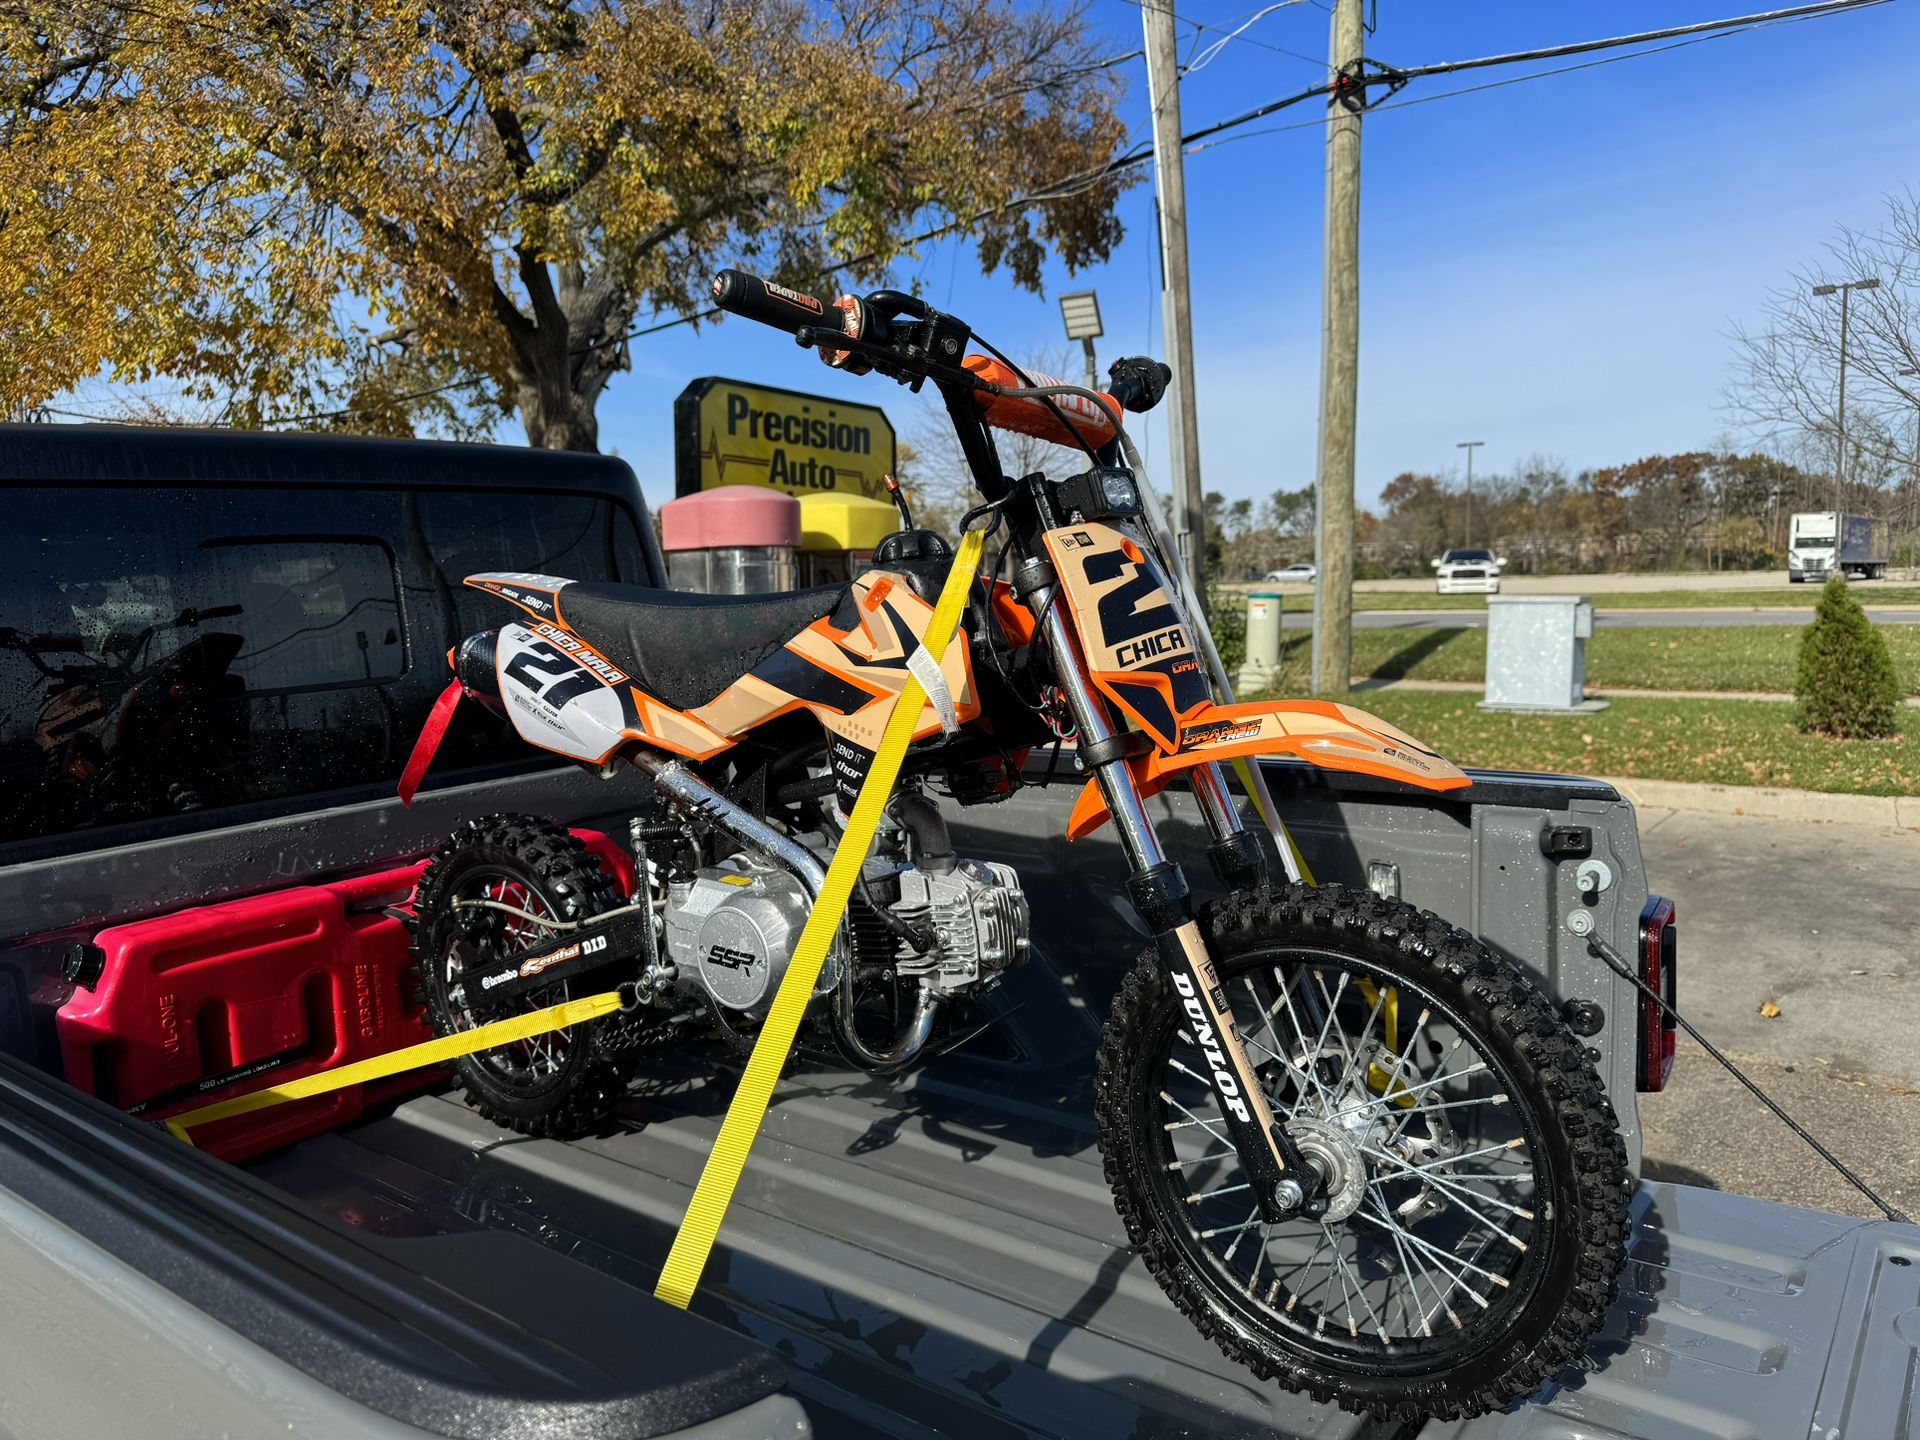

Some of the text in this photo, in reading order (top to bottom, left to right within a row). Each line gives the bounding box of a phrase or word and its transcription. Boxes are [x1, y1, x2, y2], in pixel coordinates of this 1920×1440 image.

[727, 392, 870, 455] Precision
[769, 449, 836, 490] Auto
[1082, 548, 1182, 648] 2
[536, 622, 625, 683] CHICA MALA
[1115, 628, 1186, 669] CHICA
[1182, 719, 1262, 745] ORANGE
[1215, 728, 1261, 744] CREW
[834, 742, 863, 764] SEND IT
[489, 969, 518, 987] brembo
[520, 943, 580, 977] Renthal
[707, 944, 756, 978] SSR
[355, 964, 373, 1037] GASOLINE
[1170, 970, 1251, 1123] DUNLOP
[199, 1079, 216, 1091] 500
